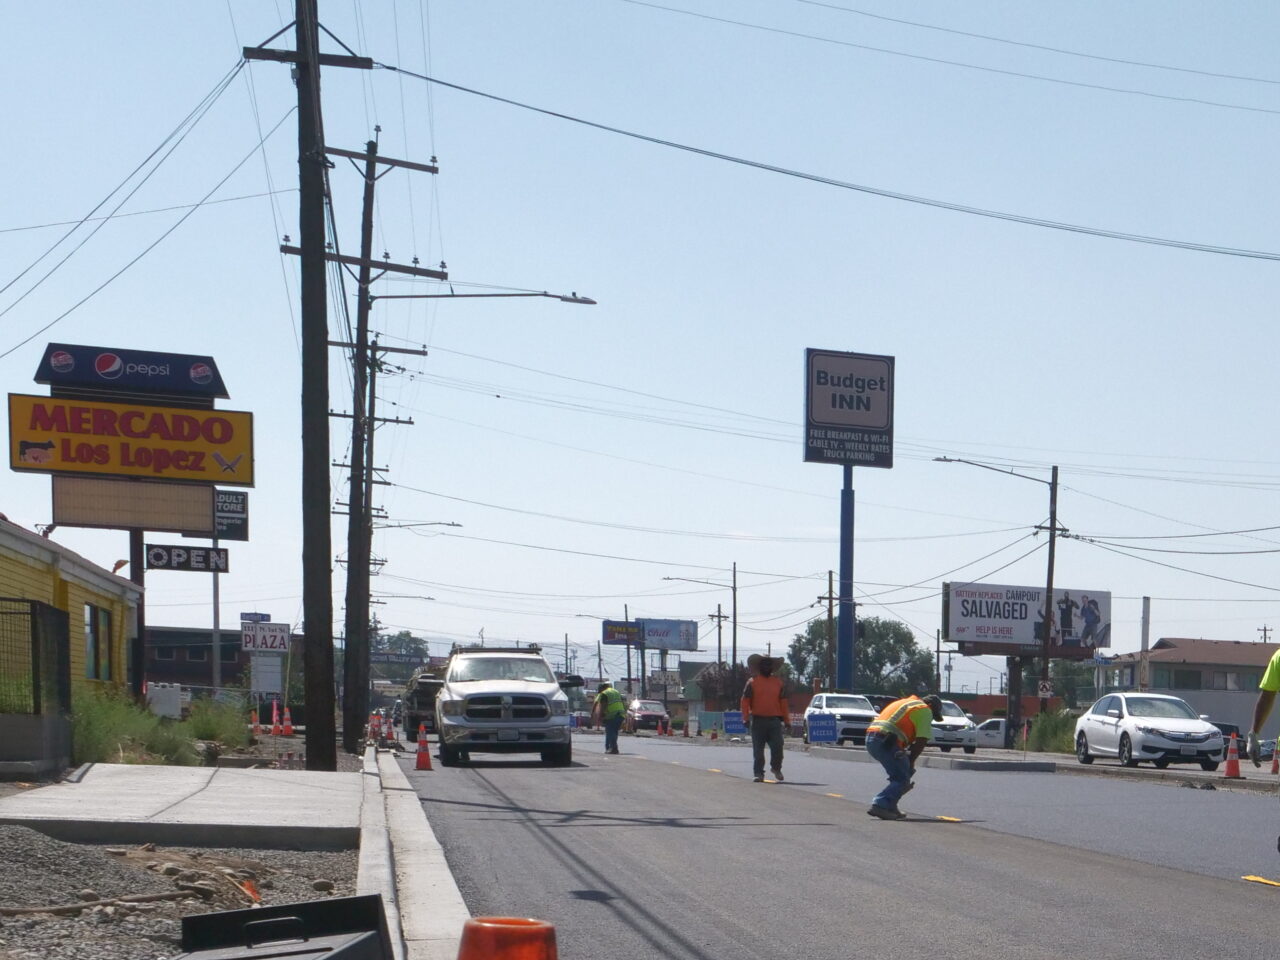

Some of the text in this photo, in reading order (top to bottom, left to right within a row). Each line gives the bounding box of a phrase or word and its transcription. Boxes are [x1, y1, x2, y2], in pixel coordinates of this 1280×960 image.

[126, 362, 170, 377] pepsi
[816, 369, 887, 394] Budget
[831, 393, 871, 411] INN
[29, 403, 234, 444] MERCADO
[810, 429, 825, 438] FREE
[827, 430, 862, 441] BREAKFAST
[808, 439, 828, 448] CABLE
[844, 441, 869, 451] WEEKLY
[871, 444, 890, 453] RATES
[60, 438, 206, 473] Los Lopez
[823, 449, 876, 461] TRUCK PARKING
[217, 494, 245, 503] DULT
[216, 502, 243, 511] TORE
[148, 547, 226, 569] OPEN
[1005, 589, 1041, 602] CAMPOUT
[961, 599, 1028, 620] SALVAGED
[975, 625, 991, 634] HELP
[991, 626, 998, 634] IS
[998, 626, 1014, 635] HERE
[244, 633, 287, 649] PLAZA
